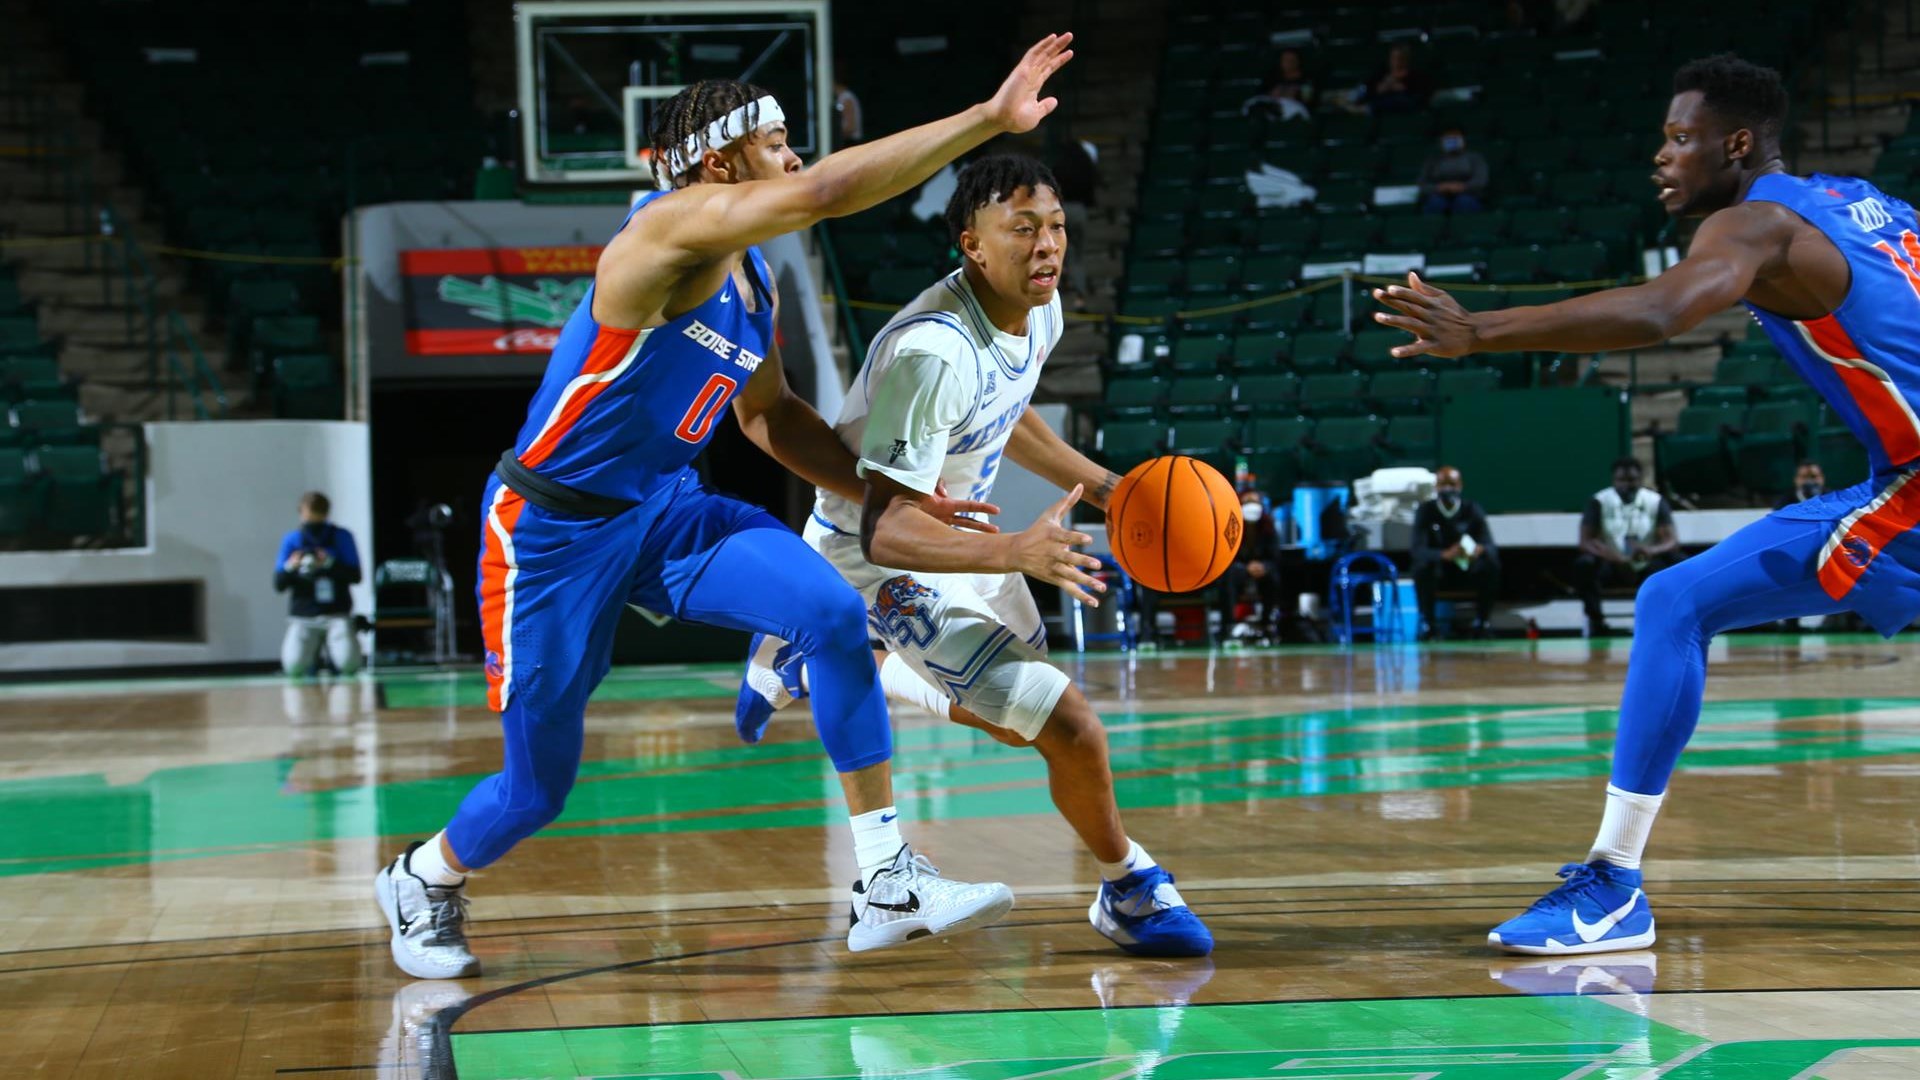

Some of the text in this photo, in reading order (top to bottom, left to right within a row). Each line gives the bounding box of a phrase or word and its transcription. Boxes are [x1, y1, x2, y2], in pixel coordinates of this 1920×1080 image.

[682, 319, 764, 373] BOISE STA
[674, 373, 737, 444] 0
